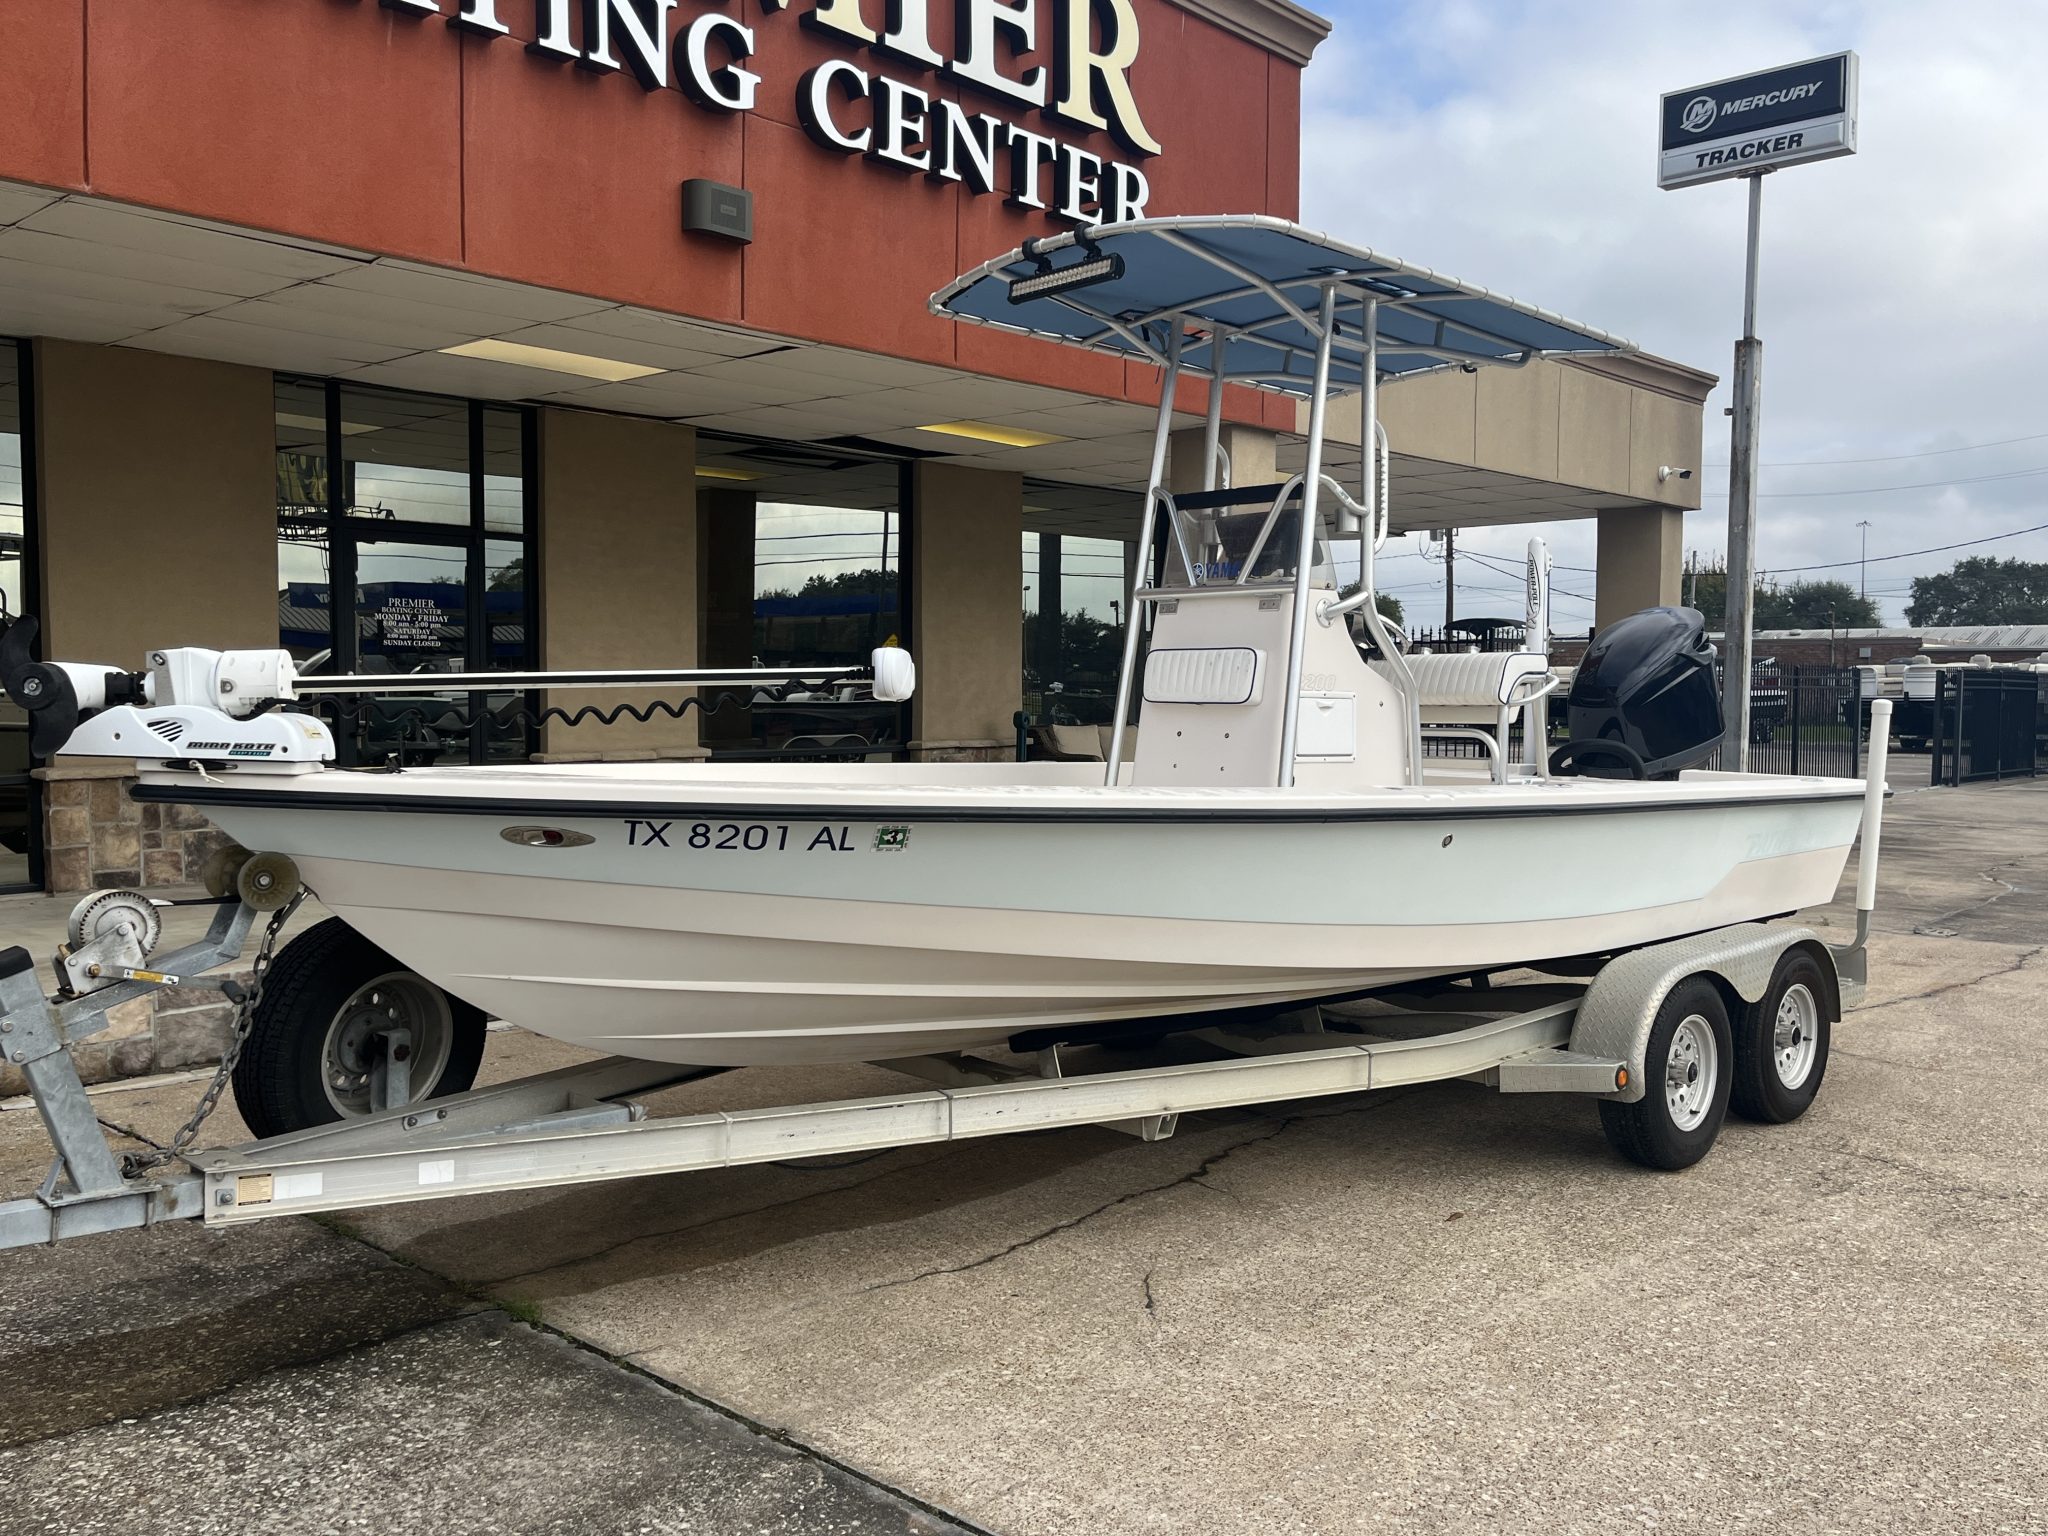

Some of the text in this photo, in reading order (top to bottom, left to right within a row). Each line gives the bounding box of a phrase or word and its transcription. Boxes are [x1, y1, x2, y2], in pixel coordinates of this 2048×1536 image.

[772, 0, 1162, 155] ER
[1720, 81, 1823, 117] MERCURY
[811, 59, 1150, 225] CENTER
[1696, 133, 1804, 168] TRACKER
[374, 613, 411, 621] MONDAY
[418, 615, 449, 623] FRIDAY
[388, 597, 435, 608] PREMIER
[1300, 673, 1337, 691] 200
[232, 742, 276, 750] KOTA
[623, 819, 673, 847] TX
[687, 823, 789, 851] 8201
[807, 825, 855, 851] AL
